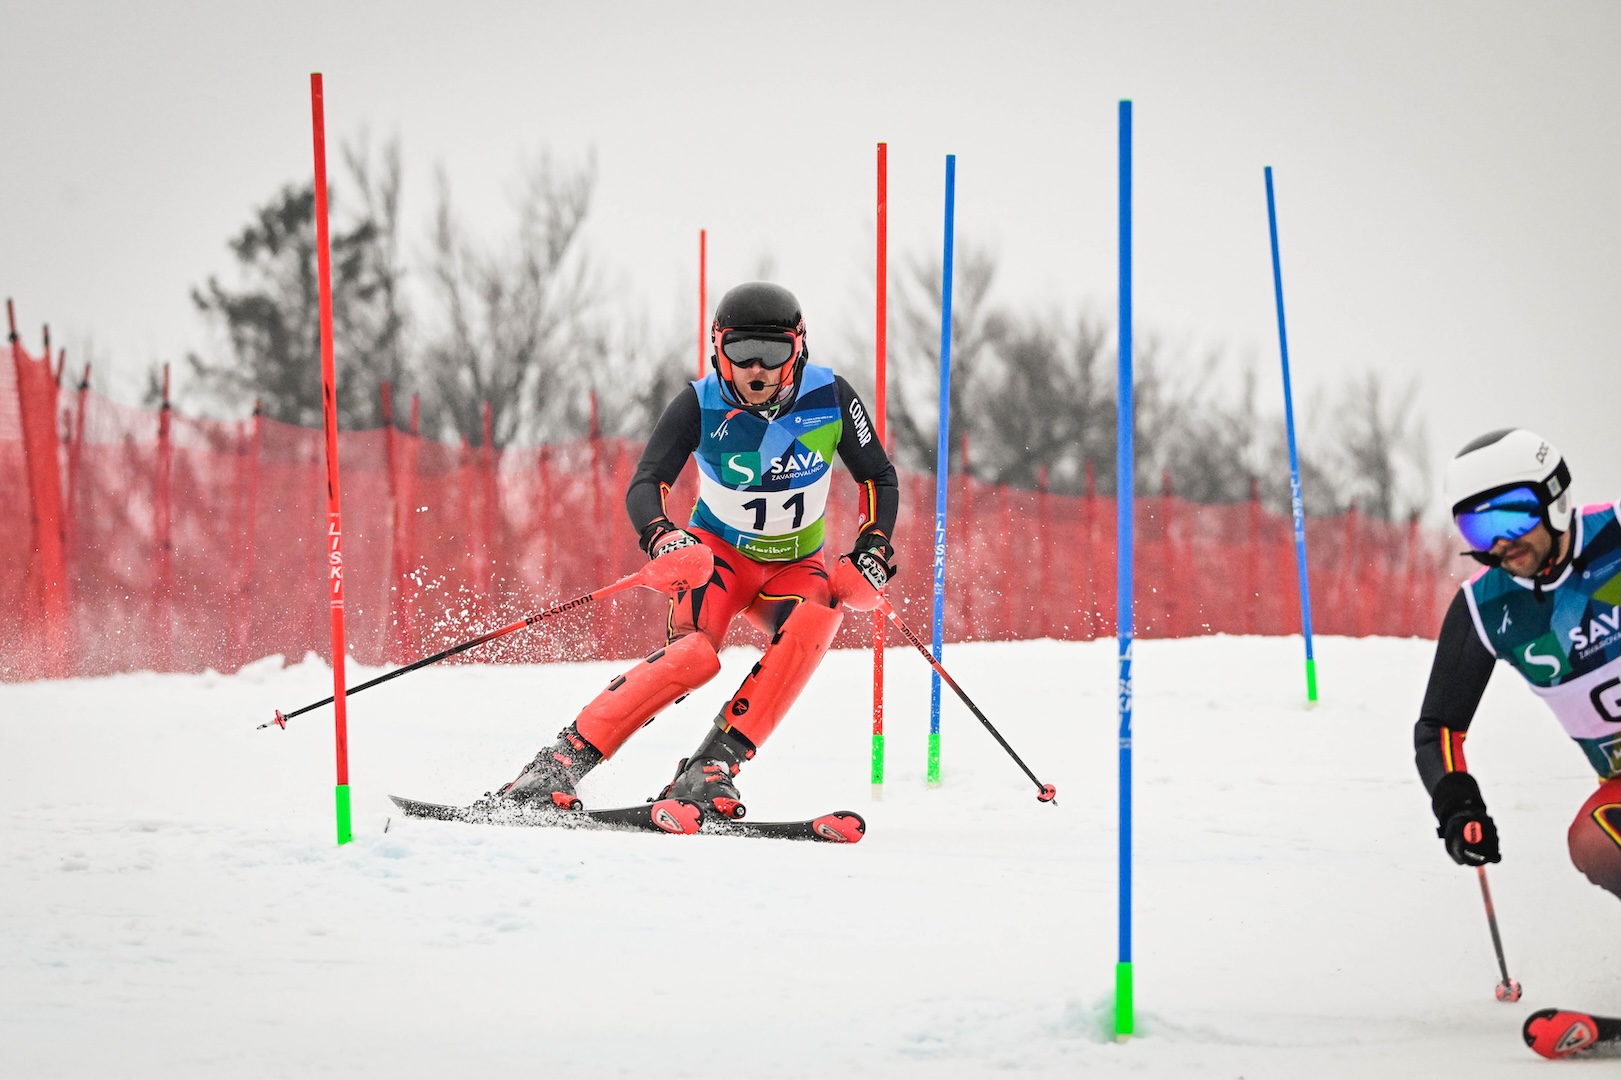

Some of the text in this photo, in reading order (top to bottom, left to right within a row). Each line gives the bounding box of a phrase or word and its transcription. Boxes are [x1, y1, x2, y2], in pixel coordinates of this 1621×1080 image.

[849, 398, 872, 448] COLMAR
[770, 449, 824, 474] SAVA
[741, 491, 804, 531] 11
[328, 522, 343, 593] LISKI
[745, 543, 792, 555] Maribor
[935, 520, 946, 579] LISKI
